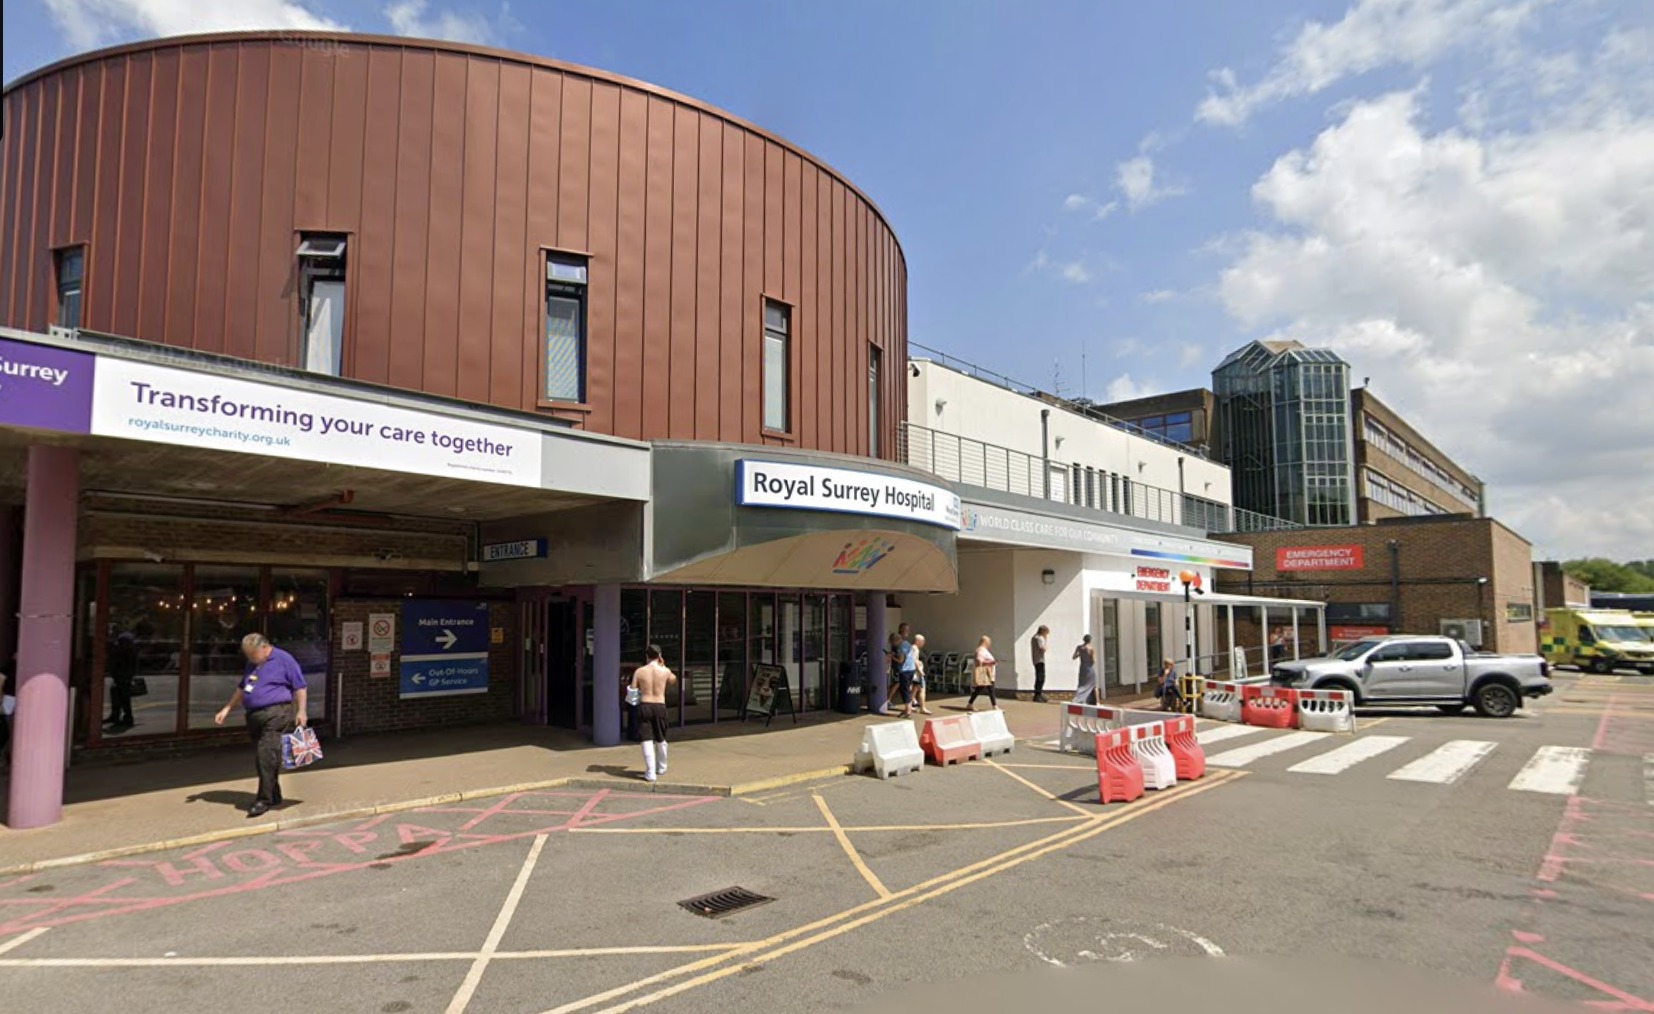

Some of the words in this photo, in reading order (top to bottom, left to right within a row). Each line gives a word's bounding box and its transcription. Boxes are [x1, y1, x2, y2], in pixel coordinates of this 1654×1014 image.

[131, 381, 314, 433] Transforming
[320, 416, 374, 437] your
[379, 425, 426, 444] care
[431, 430, 513, 457] together
[128, 416, 291, 447] royalsurreycharity.org.uk
[754, 472, 814, 499] Royal
[822, 477, 880, 508] Surrey
[885, 485, 935, 512] Hospital
[980, 515, 1009, 529] WORLD
[1010, 519, 1034, 534] CLASS
[1035, 523, 1054, 536] CARE
[1054, 526, 1068, 537] FOR
[490, 543, 529, 558] ENTRANCE
[1286, 548, 1353, 559] EMERGENCY
[1283, 557, 1356, 568] DEPARTMENT
[418, 618, 439, 626] Main
[440, 618, 474, 626] Entrance
[428, 667, 479, 677] Out-Of-Hours
[428, 679, 439, 687] GP
[441, 677, 468, 686] Service
